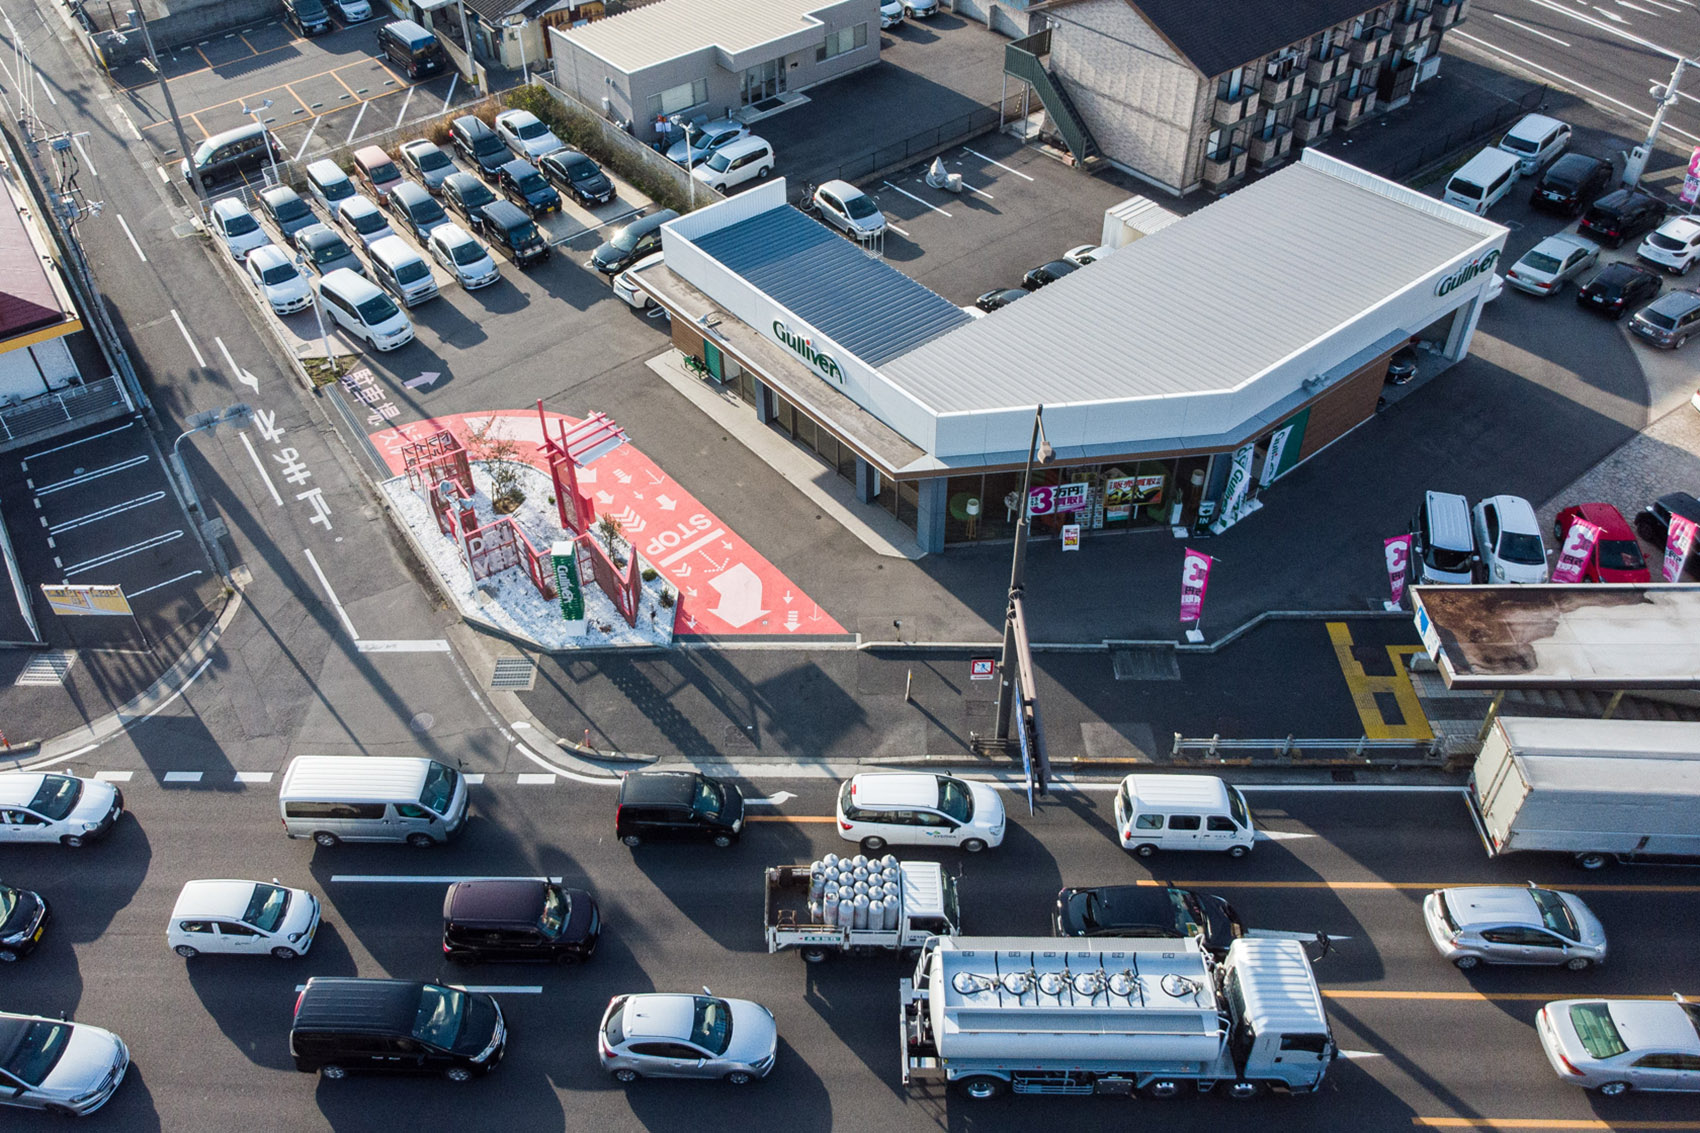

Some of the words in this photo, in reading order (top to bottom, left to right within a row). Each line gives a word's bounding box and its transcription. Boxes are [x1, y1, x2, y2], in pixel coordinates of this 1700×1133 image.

[1438, 249, 1501, 297] Gulliver
[772, 320, 843, 384] Gulliver
[254, 409, 333, 530] 止まれ
[1030, 486, 1053, 514] 3
[646, 513, 712, 555] STOP
[557, 565, 574, 604] Gulliver
